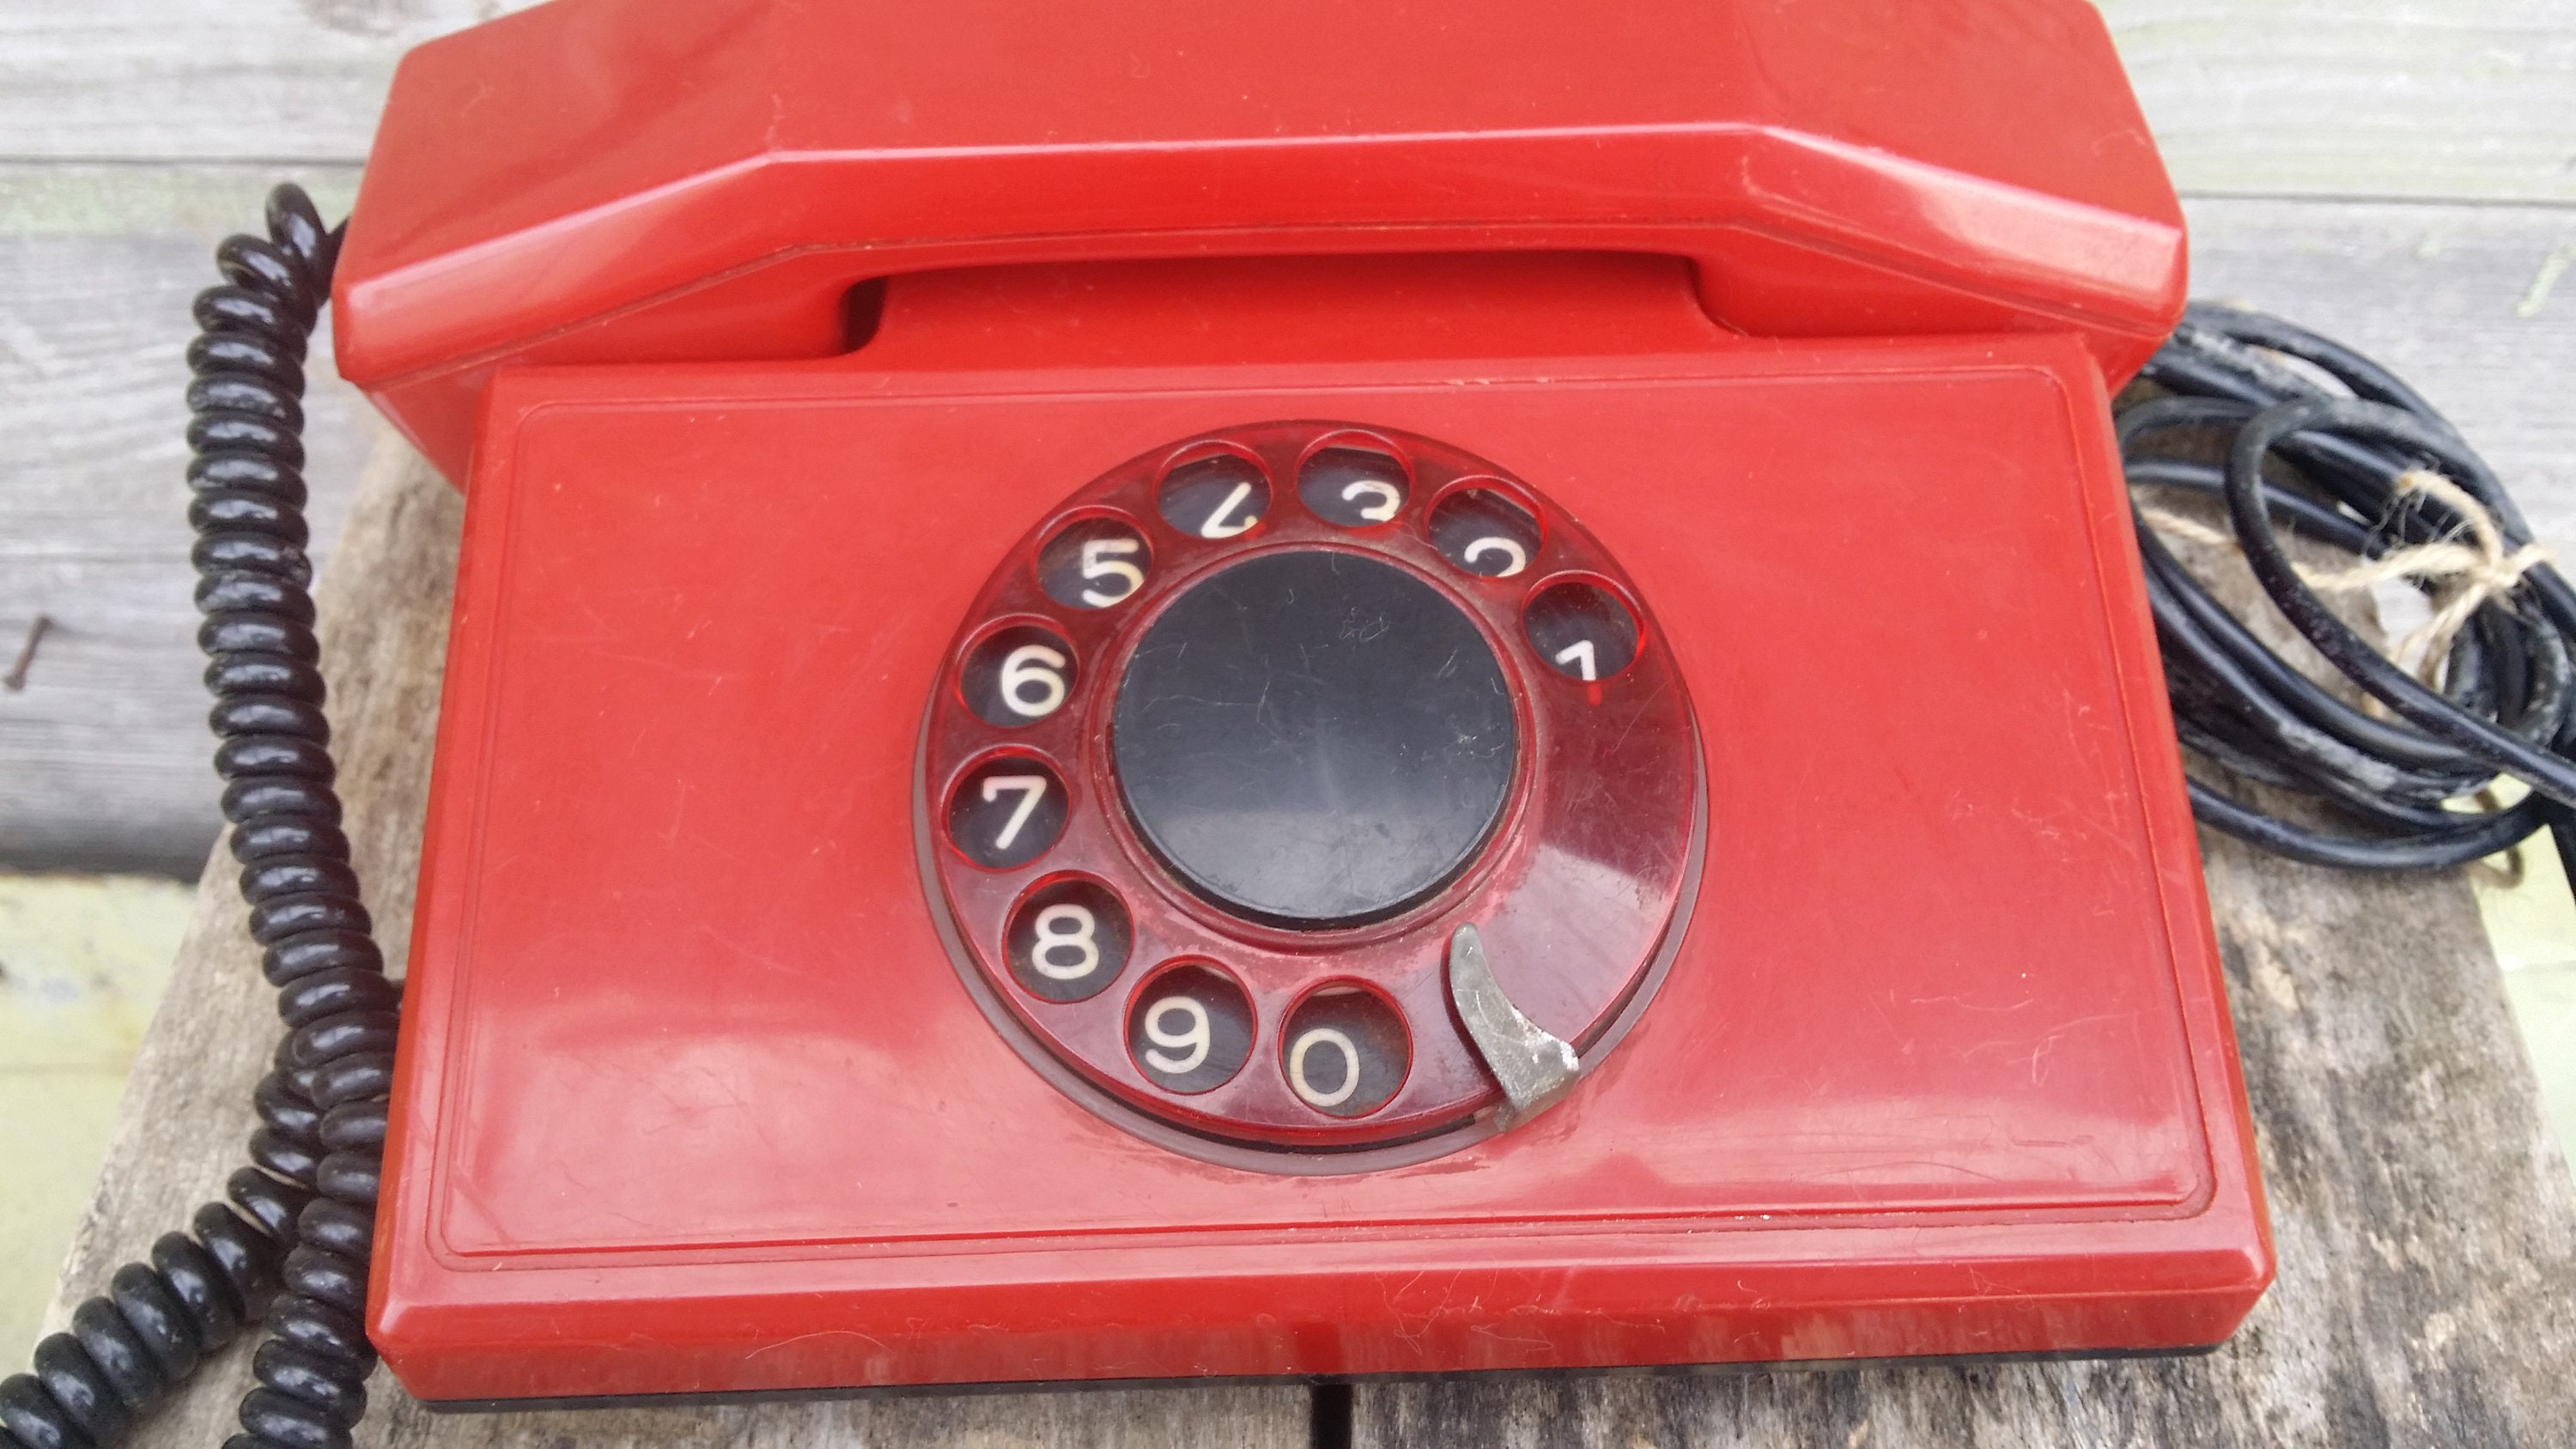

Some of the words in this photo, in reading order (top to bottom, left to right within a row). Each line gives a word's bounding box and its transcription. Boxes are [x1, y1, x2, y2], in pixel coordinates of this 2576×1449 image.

[1341, 480, 1400, 522] 3
[1078, 539, 1144, 608] 5
[999, 646, 1065, 718] 6
[982, 776, 1046, 850] 7
[1031, 905, 1099, 980] 8
[1143, 997, 1211, 1074] 9
[1290, 1028, 1360, 1106] 0
